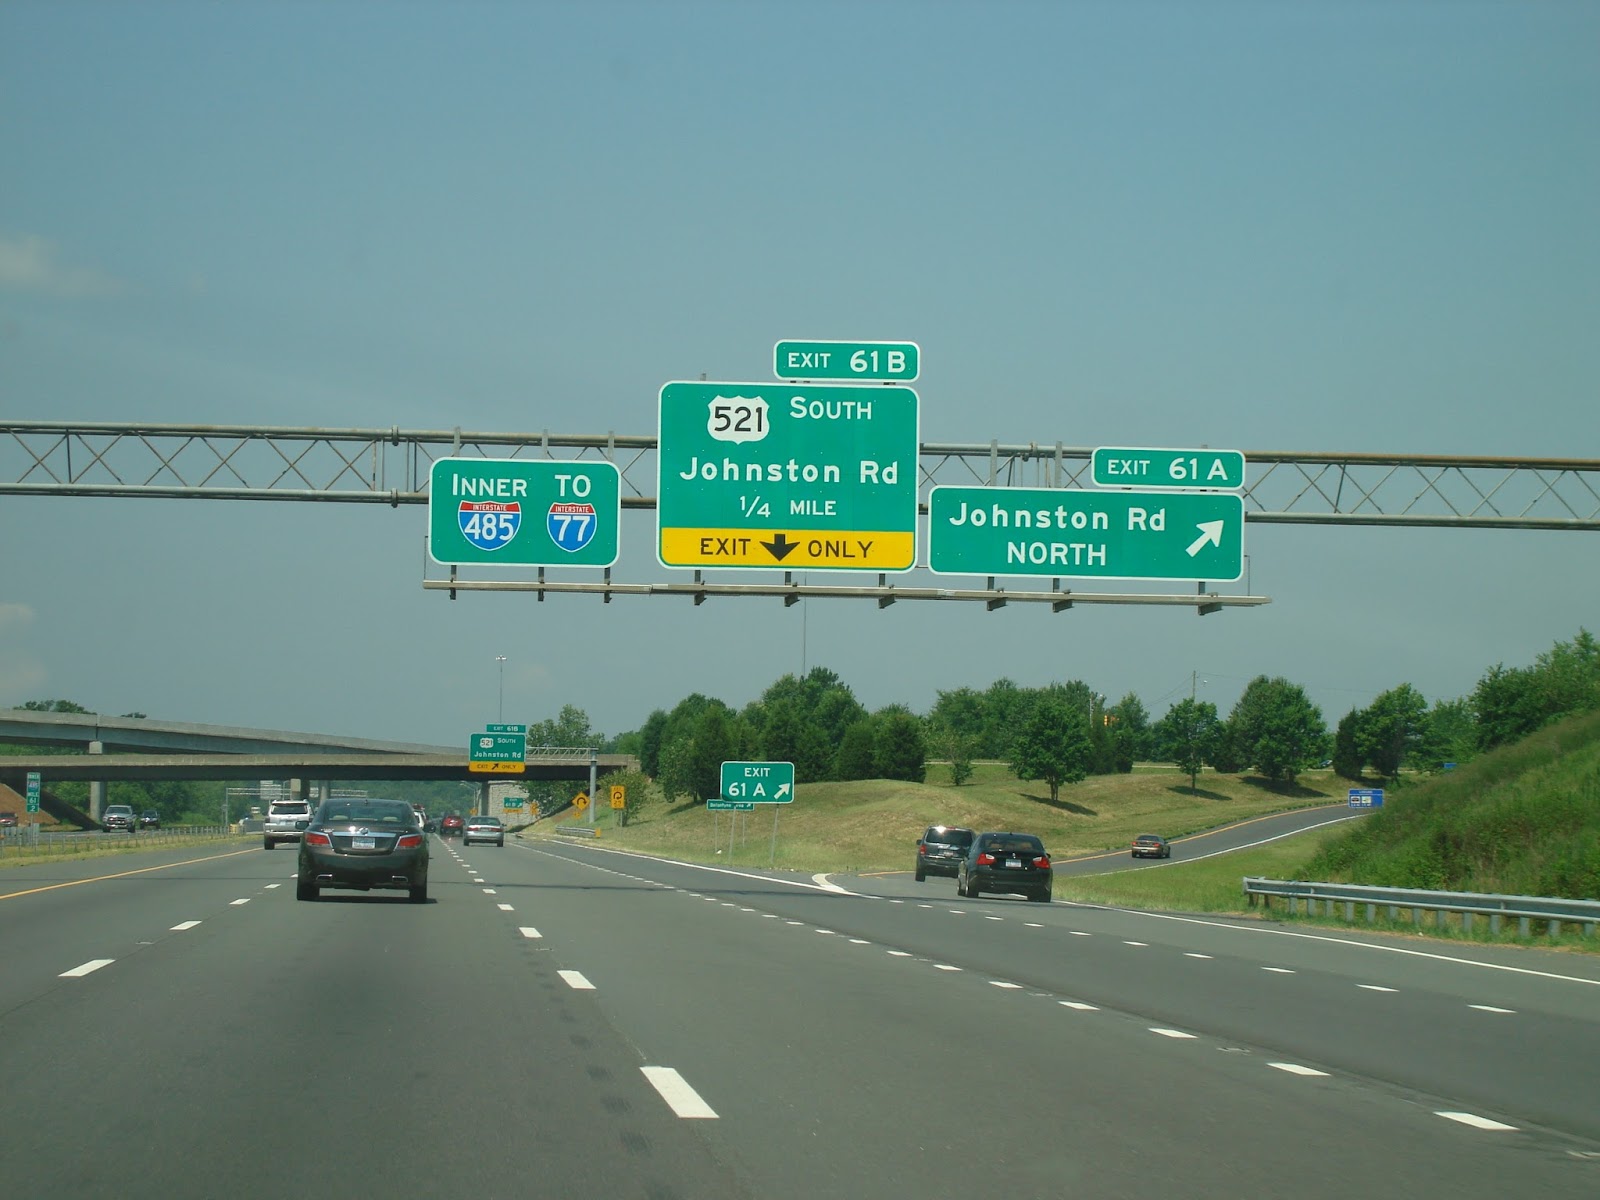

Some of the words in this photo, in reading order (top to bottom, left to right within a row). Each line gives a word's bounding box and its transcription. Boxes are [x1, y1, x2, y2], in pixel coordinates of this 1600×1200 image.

[788, 352, 831, 368] EXIT
[714, 406, 762, 432] 521
[789, 396, 872, 420] SOUTH
[679, 457, 840, 483] Johnston
[860, 460, 898, 485] Rd
[1108, 459, 1151, 475] EXIT
[452, 473, 527, 497] INNER
[554, 474, 591, 498] TO
[472, 504, 507, 512] INTERSTATE
[555, 506, 590, 514] INTERSTATE
[790, 500, 837, 516] MILE
[949, 502, 1108, 530] Johnston
[1128, 507, 1165, 531] Rd
[464, 513, 515, 541] 485
[553, 514, 591, 542] 77
[700, 538, 751, 555] EXIT
[808, 540, 874, 559] ONLY
[1007, 541, 1106, 566] NORTH
[512, 751, 522, 759] Rd
[744, 767, 771, 777] EXIT
